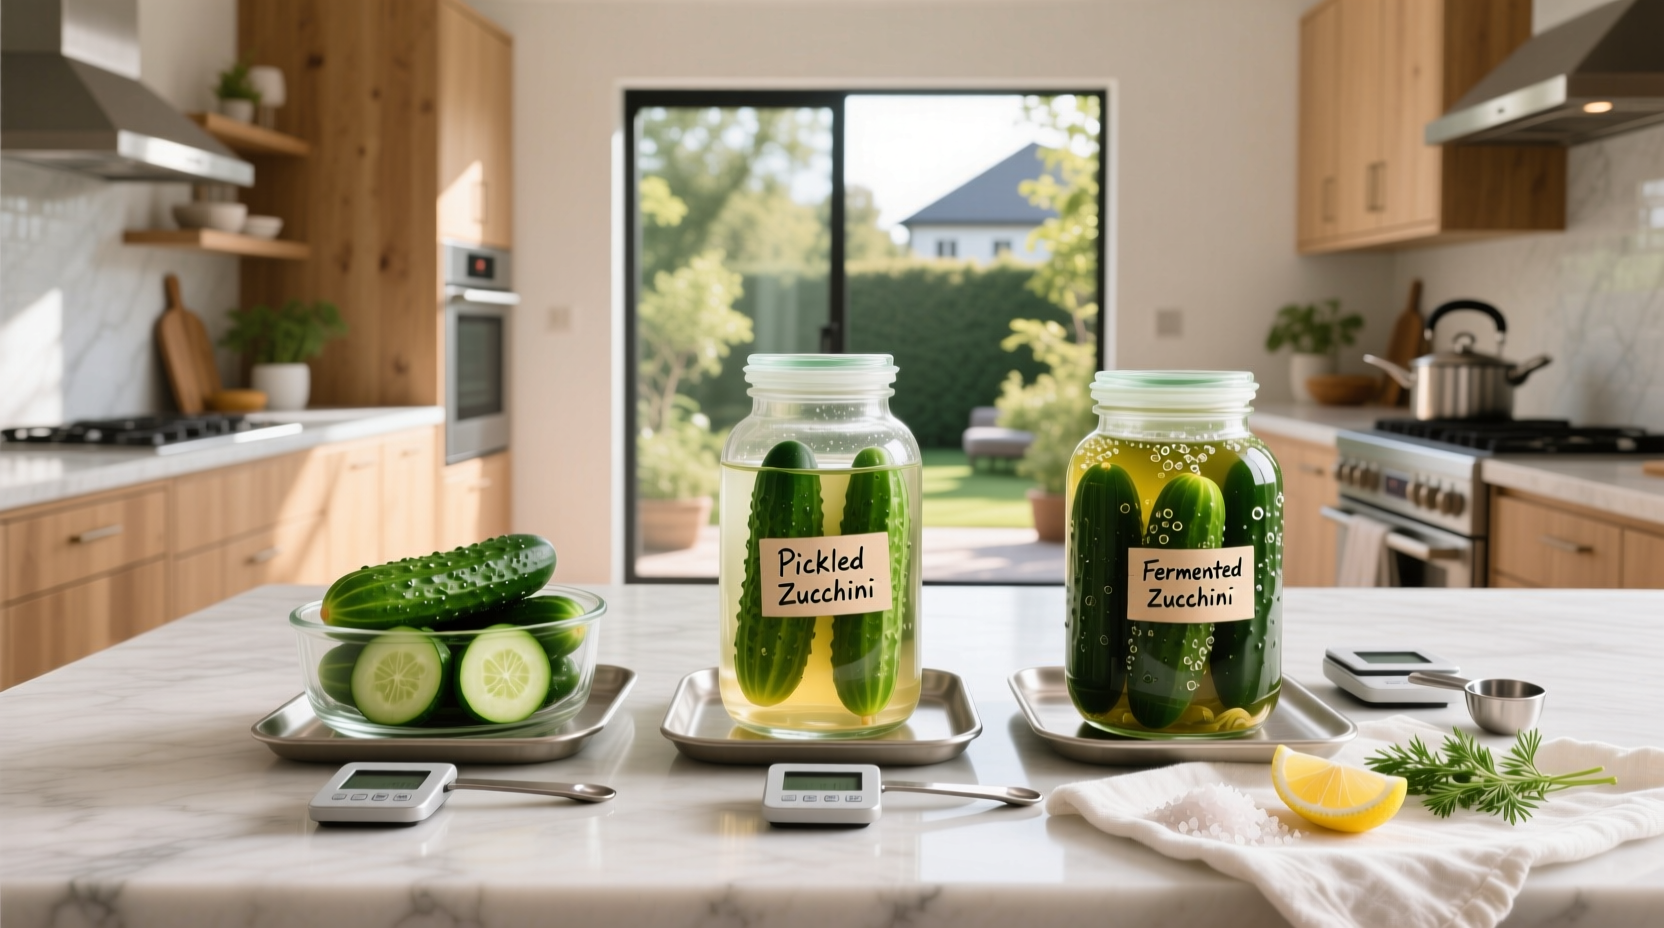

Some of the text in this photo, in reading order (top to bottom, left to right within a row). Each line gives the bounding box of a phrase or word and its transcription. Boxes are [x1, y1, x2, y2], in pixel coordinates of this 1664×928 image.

[778, 546, 864, 577] Pickled
[1143, 556, 1242, 581] Fermented
[778, 578, 874, 606] Zucchini
[1147, 586, 1234, 608] Zucchini
